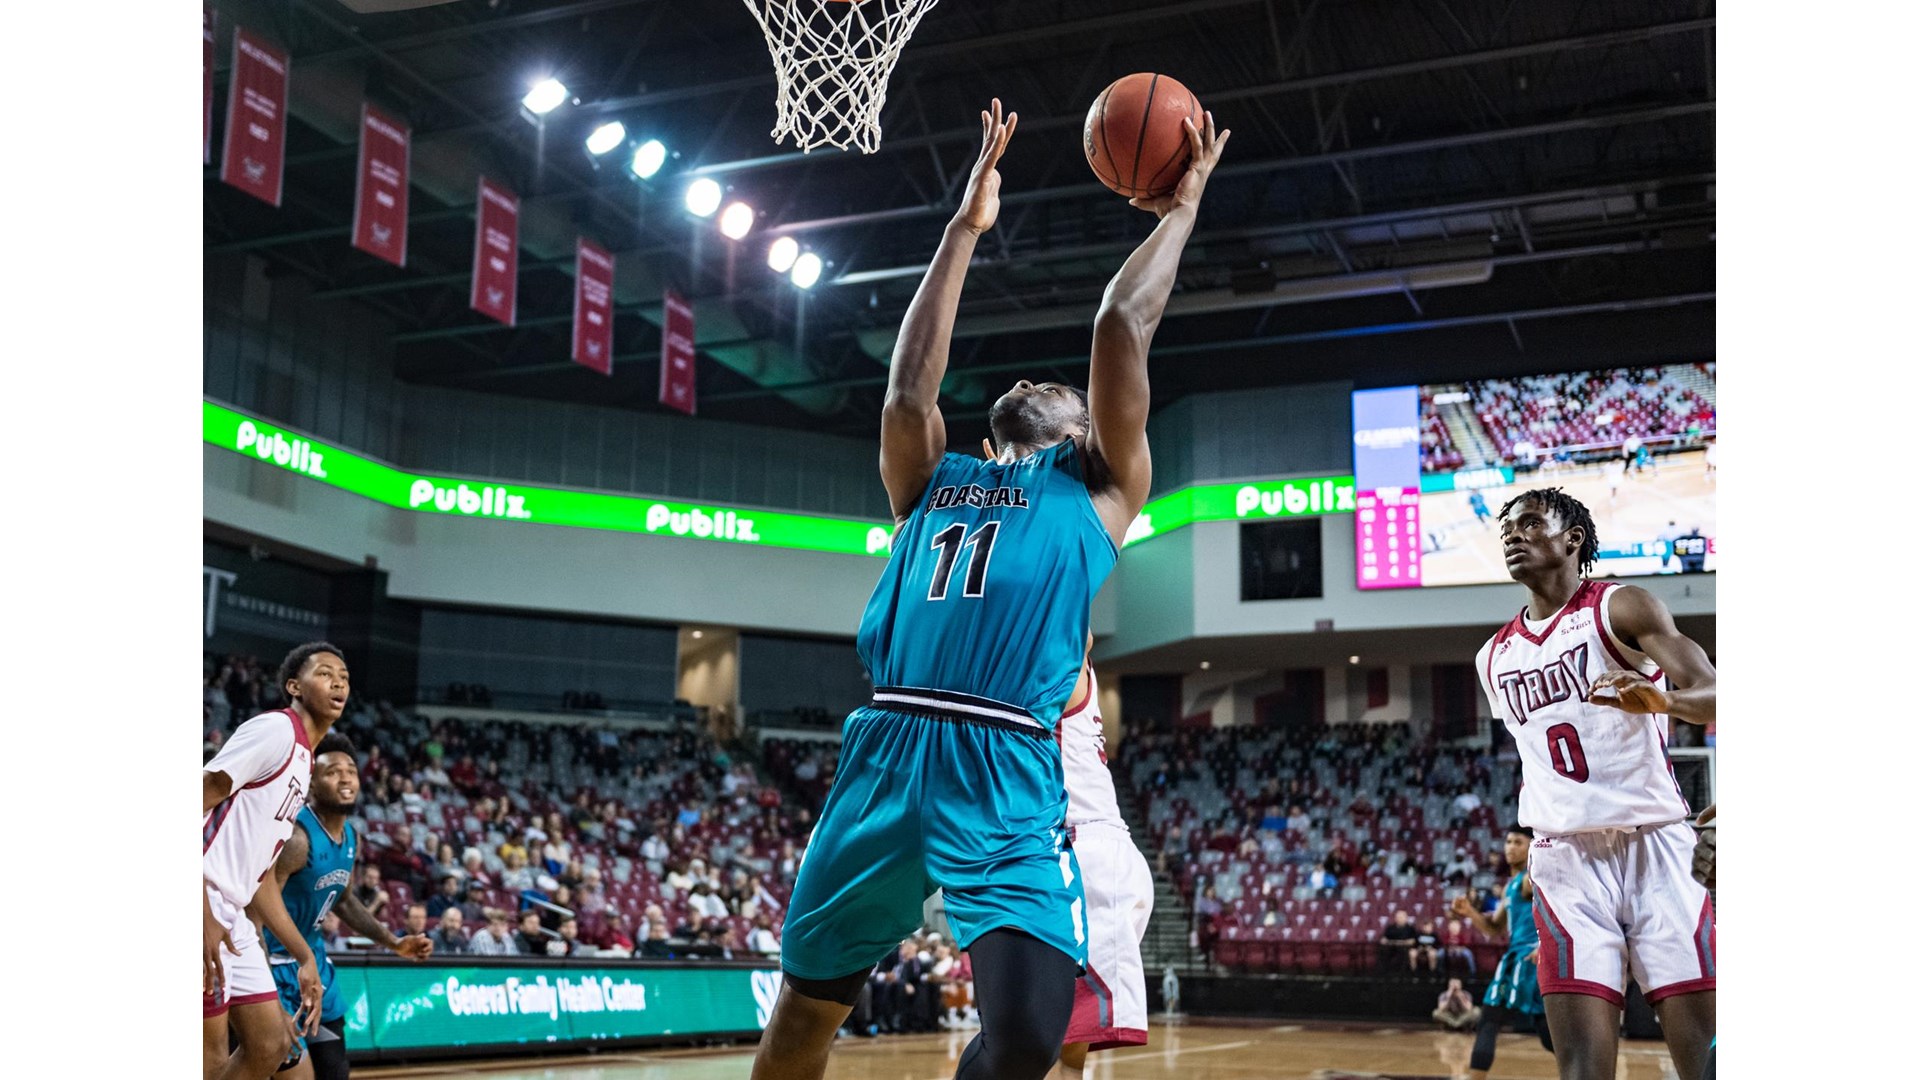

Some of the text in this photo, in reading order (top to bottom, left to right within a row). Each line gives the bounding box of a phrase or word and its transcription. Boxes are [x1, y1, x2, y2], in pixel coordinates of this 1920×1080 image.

[925, 484, 1029, 517] COASTAL
[927, 521, 1001, 602] 11
[1498, 642, 1590, 726] TROY
[1546, 722, 1590, 783] 0
[446, 975, 509, 1016] Geneva
[507, 974, 558, 1021] Family
[556, 975, 605, 1013] Health
[601, 976, 646, 1011] Center
